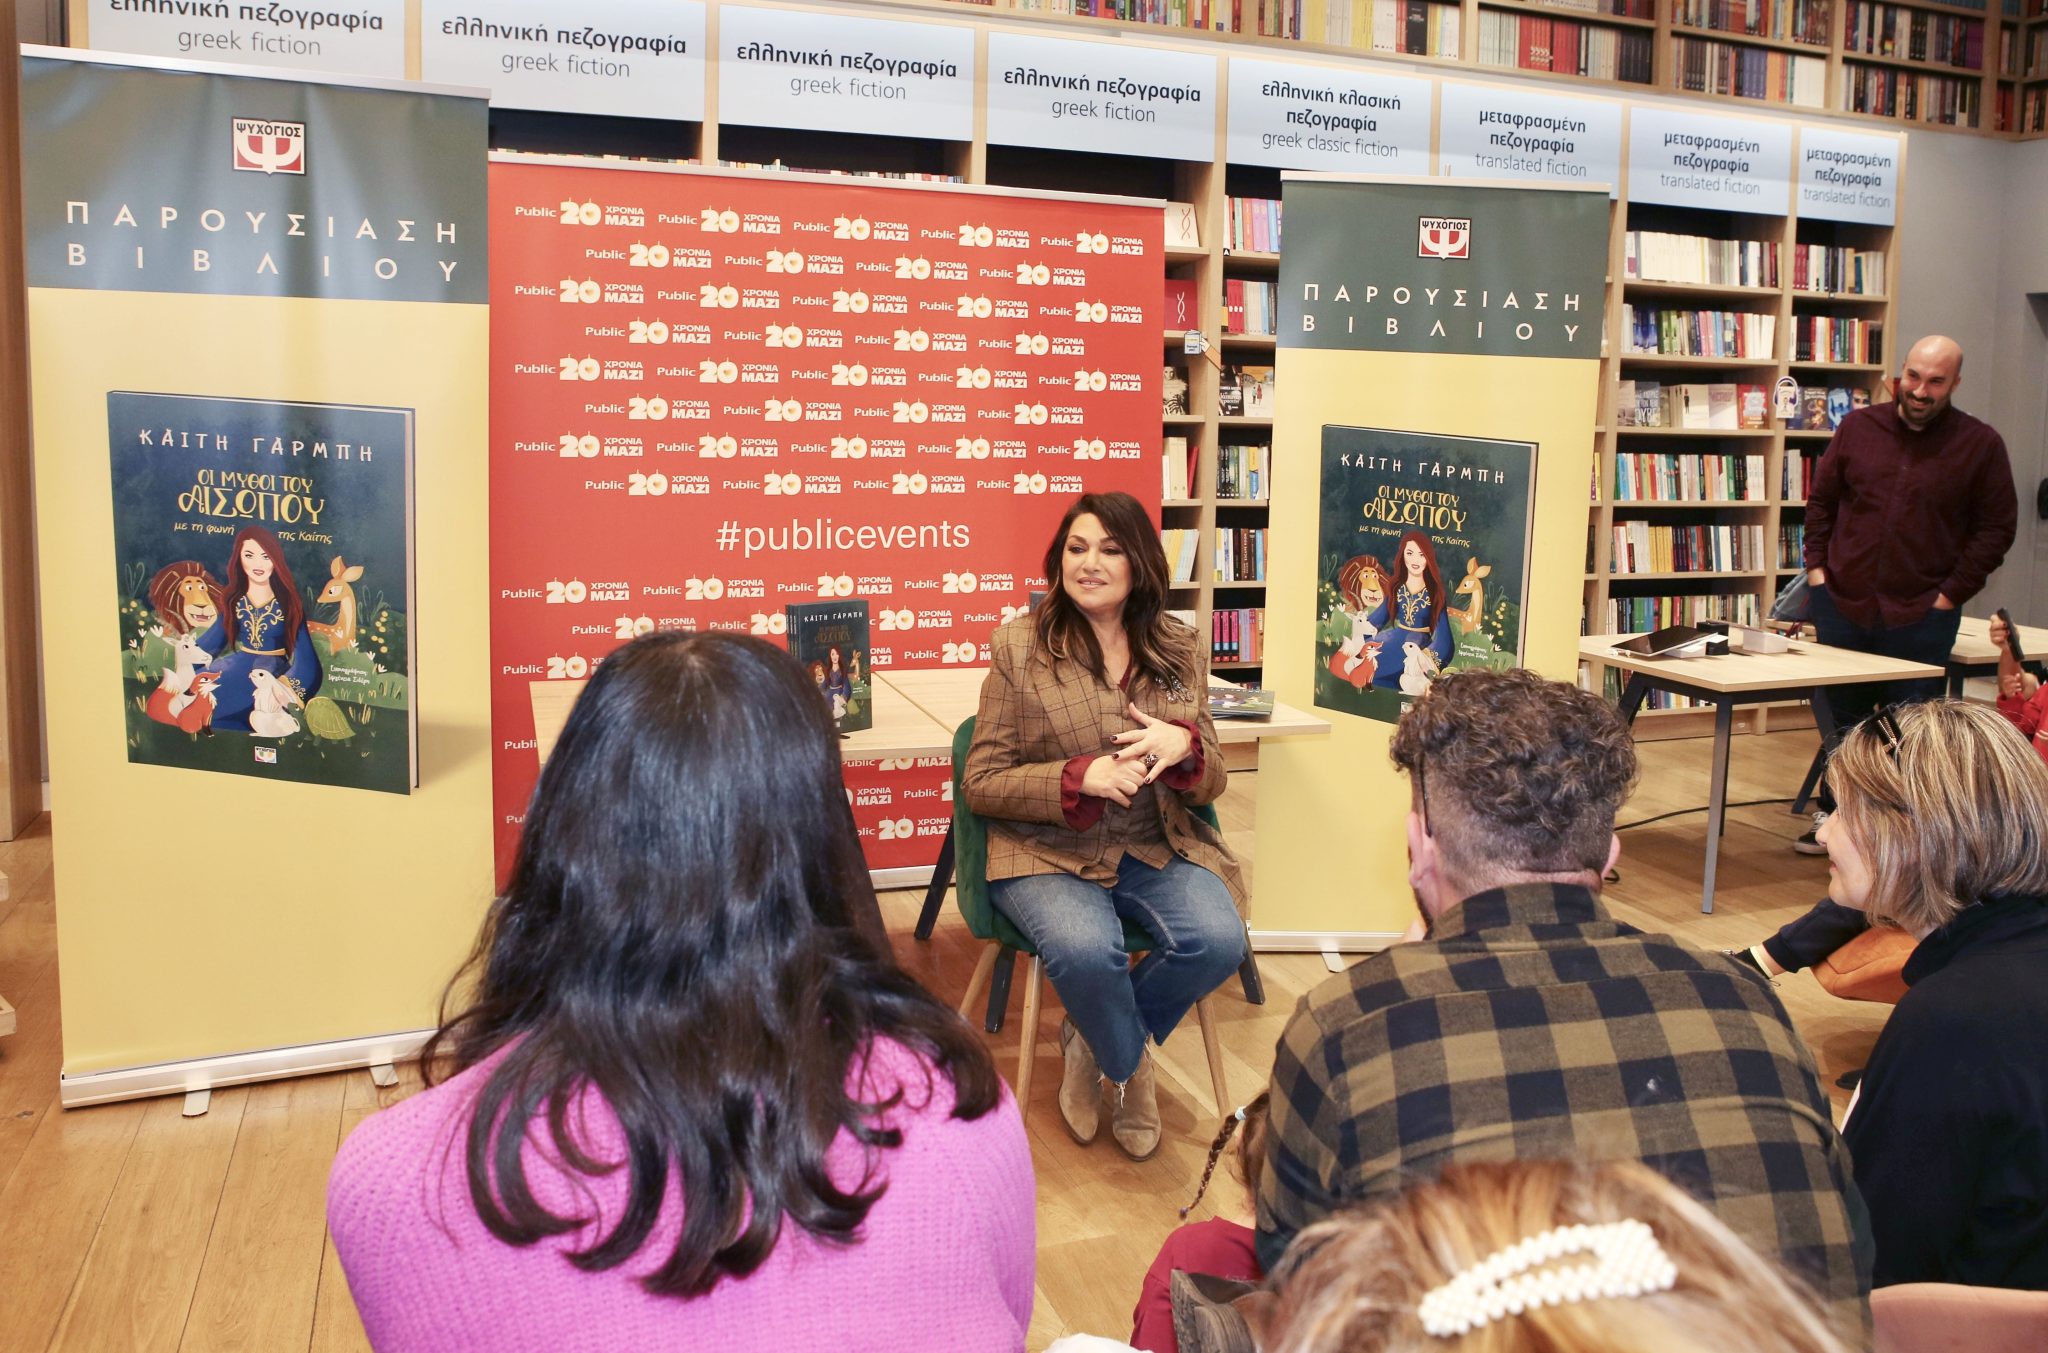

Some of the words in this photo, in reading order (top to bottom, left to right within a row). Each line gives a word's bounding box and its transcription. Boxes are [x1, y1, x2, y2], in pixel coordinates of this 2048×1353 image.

[239, 6, 383, 32] πεζογραφία
[178, 30, 241, 51] greek
[251, 32, 321, 55] fiction
[442, 17, 548, 42] ελληνική
[557, 27, 686, 56] πεζογραφία
[502, 53, 558, 73] greek
[568, 54, 630, 77] fiction
[737, 43, 832, 66] ελληνική
[841, 52, 957, 79] πεζογραφία
[791, 77, 842, 95] greek
[850, 78, 906, 99] fiction
[1004, 68, 1090, 91] ελληνική
[1097, 78, 1201, 104] πεζογραφία
[1262, 81, 1334, 102] ελληνική
[1339, 89, 1401, 110] κλασική
[1052, 100, 1098, 118] greek
[1105, 102, 1155, 122] fiction
[1286, 109, 1377, 133] πεζογραφία
[1479, 110, 1586, 133] μεταφρασμένη
[236, 122, 301, 137] ΨΥΧΟΓΙΟΣ
[1262, 132, 1302, 149] greek
[1307, 134, 1351, 153] classic
[1355, 138, 1398, 157] fiction
[1490, 132, 1574, 155] πεζογραφία
[1664, 132, 1760, 153] μεταφρασμένη
[1475, 153, 1542, 172] translated
[1547, 159, 1587, 177] fiction
[1674, 152, 1750, 174] πεζογραφία
[1807, 148, 1891, 168] μεταφρασμένη
[1660, 173, 1721, 191] translated
[1724, 177, 1760, 195] fiction
[1815, 168, 1882, 188] πεζογραφία
[1804, 187, 1856, 205] translated
[1859, 191, 1891, 209] fiction
[514, 206, 557, 218] Public
[559, 201, 602, 227] 20
[604, 214, 645, 227] ΜΑΖΙ
[605, 205, 645, 216] ΧΡΟΝΙΑ
[658, 213, 698, 225] Public
[700, 209, 741, 234] 20
[743, 213, 781, 223] ΧΡΟΝΙΑ
[67, 201, 457, 244] ΠΑΡΟΥΣΙΑΣΗ
[742, 221, 781, 235] ΜΑΖΙ
[793, 221, 831, 233] Public
[833, 217, 871, 241] 20
[873, 221, 909, 231] ΧΡΟΝΙΑ
[1422, 221, 1468, 230] ΨΥΧΟΓΙΟΣ
[873, 229, 910, 242] ΜΑΖΙ
[920, 229, 956, 240] Public
[958, 224, 994, 248] 20
[995, 236, 1030, 249] ΜΑΖΙ
[996, 229, 1030, 239] ΧΡΟΝΙΑ
[1040, 236, 1074, 247] Public
[1075, 232, 1110, 255] 20
[1111, 236, 1144, 246] ΧΡΟΝΙΑ
[585, 248, 627, 260] Public
[629, 243, 670, 268] 20
[673, 247, 712, 257] ΧΡΟΝΙΑ
[807, 254, 844, 264] ΧΡΟΝΙΑ
[1111, 243, 1144, 256] ΜΑΖΙ
[68, 243, 458, 282] ΒΙΒΛΙΟΥ
[672, 256, 712, 269] ΜΑΖΙ
[724, 255, 763, 266] Public
[765, 250, 805, 275] 20
[806, 262, 844, 275] ΜΑΖΙ
[855, 261, 893, 273] Public
[894, 257, 932, 281] 20
[934, 260, 969, 270] ΧΡΟΝΙΑ
[1053, 267, 1086, 277] ΧΡΟΝΙΑ
[933, 268, 969, 281] ΜΑΖΙ
[979, 268, 1014, 279] Public
[1016, 263, 1051, 287] 20
[1052, 274, 1086, 287] ΜΑΖΙ
[514, 285, 556, 296] Public
[559, 279, 602, 304] 20
[604, 283, 644, 293] ΧΡΟΝΙΑ
[604, 291, 645, 304] ΜΑΖΙ
[657, 290, 697, 301] Public
[699, 285, 740, 309] 20
[742, 288, 780, 298] ΧΡΟΝΙΑ
[872, 294, 908, 303] ΧΡΟΝΙΑ
[1303, 283, 1579, 311] ΠΑΡΟΥΣΙΑΣΗ
[741, 296, 780, 309] ΜΑΖΙ
[792, 295, 830, 306] Public
[832, 290, 870, 314] 20
[871, 302, 908, 314] ΜΑΖΙ
[919, 301, 955, 312] Public
[956, 296, 993, 319] 20
[994, 307, 1029, 319] ΜΑΖΙ
[995, 299, 1029, 309] ΧΡΟΝΙΑ
[1039, 306, 1073, 317] Public
[1074, 301, 1109, 324] 20
[1110, 304, 1143, 314] ΧΡΟΝΙΑ
[1110, 312, 1143, 324] ΜΑΖΙ
[1303, 315, 1579, 342] ΒΙΒΛΙΟΥ
[139, 428, 228, 451] ΚΑΙΤΗ
[252, 437, 373, 462] ΓΑΡΜΠΗ
[1341, 453, 1402, 472] ΚΑΙΤΗ
[1418, 462, 1505, 484] ΓΑΡΜΠΗ
[197, 469, 214, 486] ΟΙ
[221, 471, 276, 490] ΜΥΘΟΙ
[279, 475, 314, 494] ΤΟΥ
[178, 484, 325, 525] ΑΙΣΩΠΟΥ
[1378, 485, 1390, 499] ΟΙ
[1394, 487, 1433, 504] ΜΥΘΟΙ
[1436, 492, 1461, 508] ΤΟΥ
[1363, 497, 1467, 532] ΑΙΣΩΠΟΥ
[174, 522, 188, 532] με
[191, 523, 204, 534] τη
[206, 523, 235, 536] φωνή
[716, 518, 970, 558] #publicevents
[590, 581, 630, 590] ΧΡΟΝΙΑ
[727, 578, 765, 587] ΧΡΟΝΙΑ
[777, 582, 814, 593] Public
[816, 575, 855, 598] 20
[857, 576, 893, 585] ΧΡΟΝΙΑ
[904, 579, 940, 589] Public
[941, 572, 978, 594] 20
[979, 580, 1014, 592] ΜΑΖΙ
[980, 573, 1014, 582] ΧΡΟΝΙΑ
[501, 588, 543, 599] Public
[545, 580, 587, 604] 20
[590, 589, 630, 602] ΜΑΖΙ
[642, 585, 682, 596] Public
[684, 577, 725, 601] 20
[726, 586, 765, 599] ΜΑΖΙ
[856, 583, 893, 595] ΜΑΖΙ
[658, 617, 697, 626] ΧΡΟΝΙΑ
[709, 620, 748, 631] Public
[751, 613, 786, 635] 20
[879, 607, 915, 631] 20
[918, 609, 952, 618] ΧΡΟΝΙΑ
[918, 617, 952, 628] ΜΑΖΙ
[571, 624, 612, 635] Public
[904, 650, 939, 660] Public
[942, 642, 977, 664] 20
[503, 664, 543, 675] Public
[547, 655, 588, 679] 20
[903, 788, 939, 799] Public
